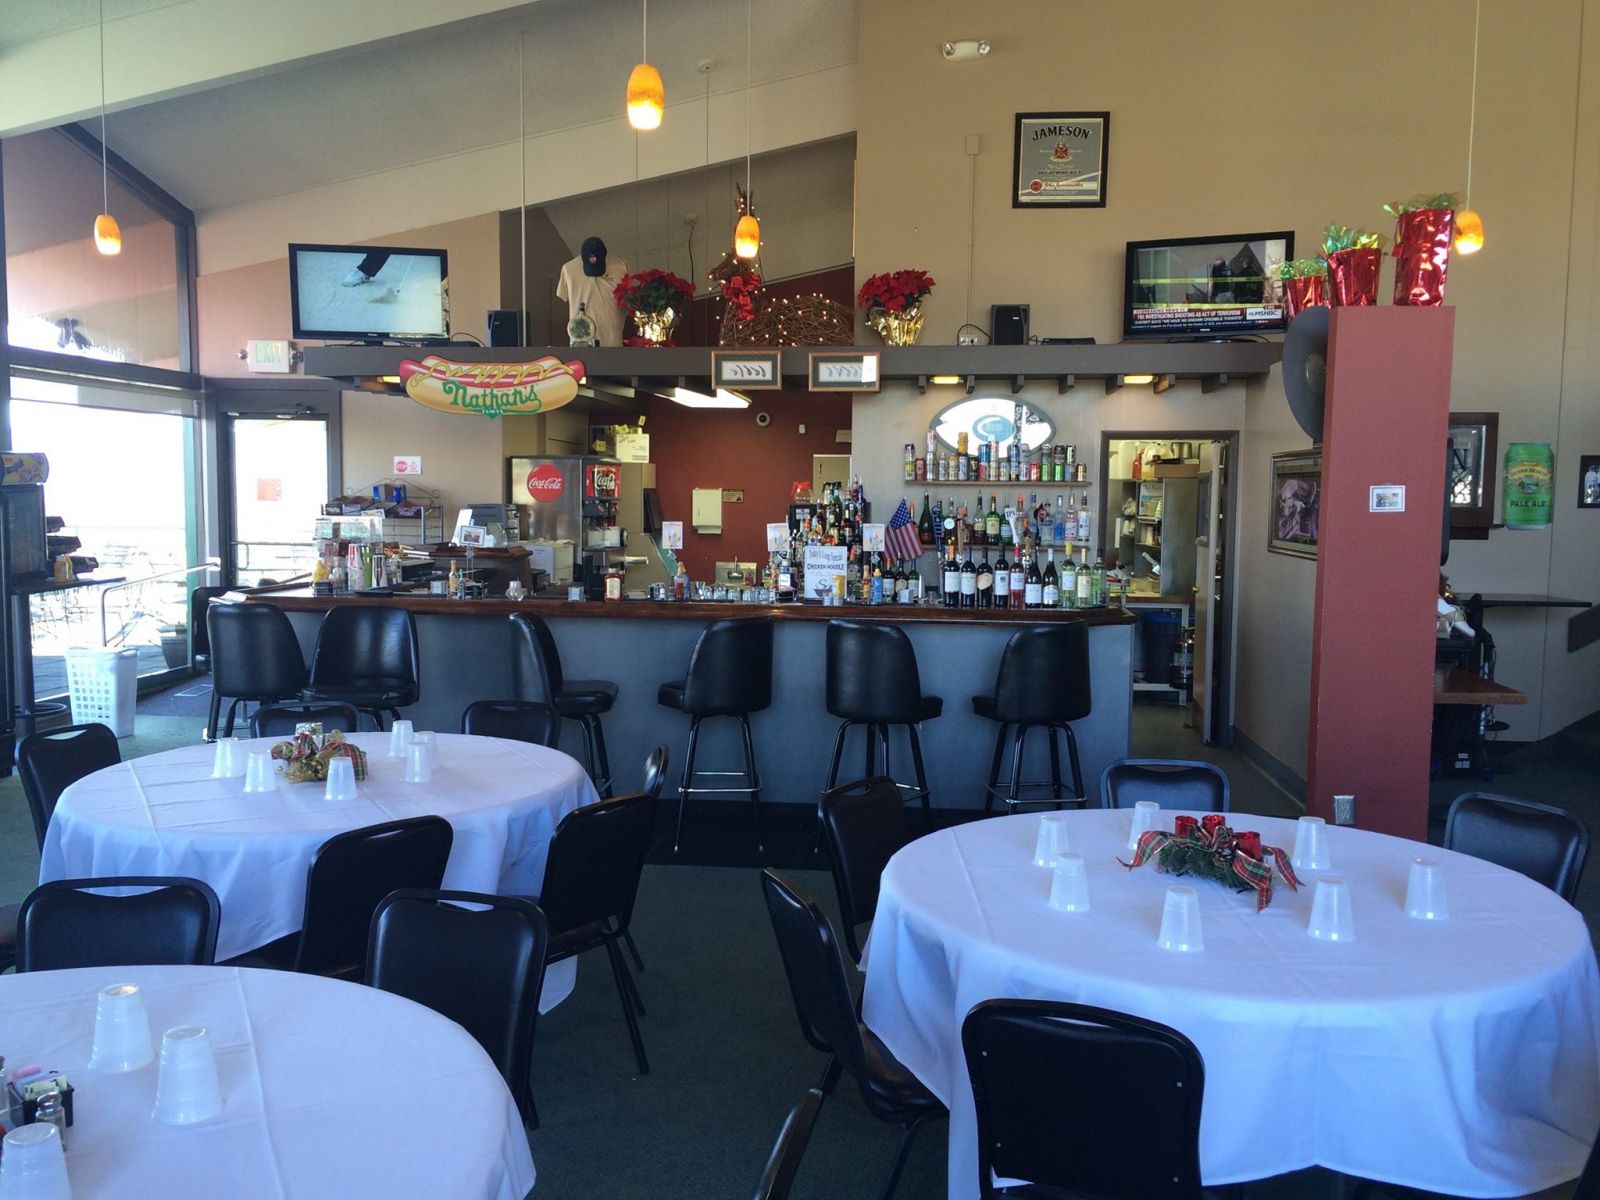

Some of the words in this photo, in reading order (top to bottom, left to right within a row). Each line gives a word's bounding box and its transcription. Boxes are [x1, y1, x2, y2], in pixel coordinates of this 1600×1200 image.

[1032, 125, 1090, 141] JAMESON
[255, 341, 281, 363] EXIT
[442, 380, 541, 413] Nathan's
[1510, 500, 1530, 508] PALE
[1530, 500, 1547, 508] ALE
